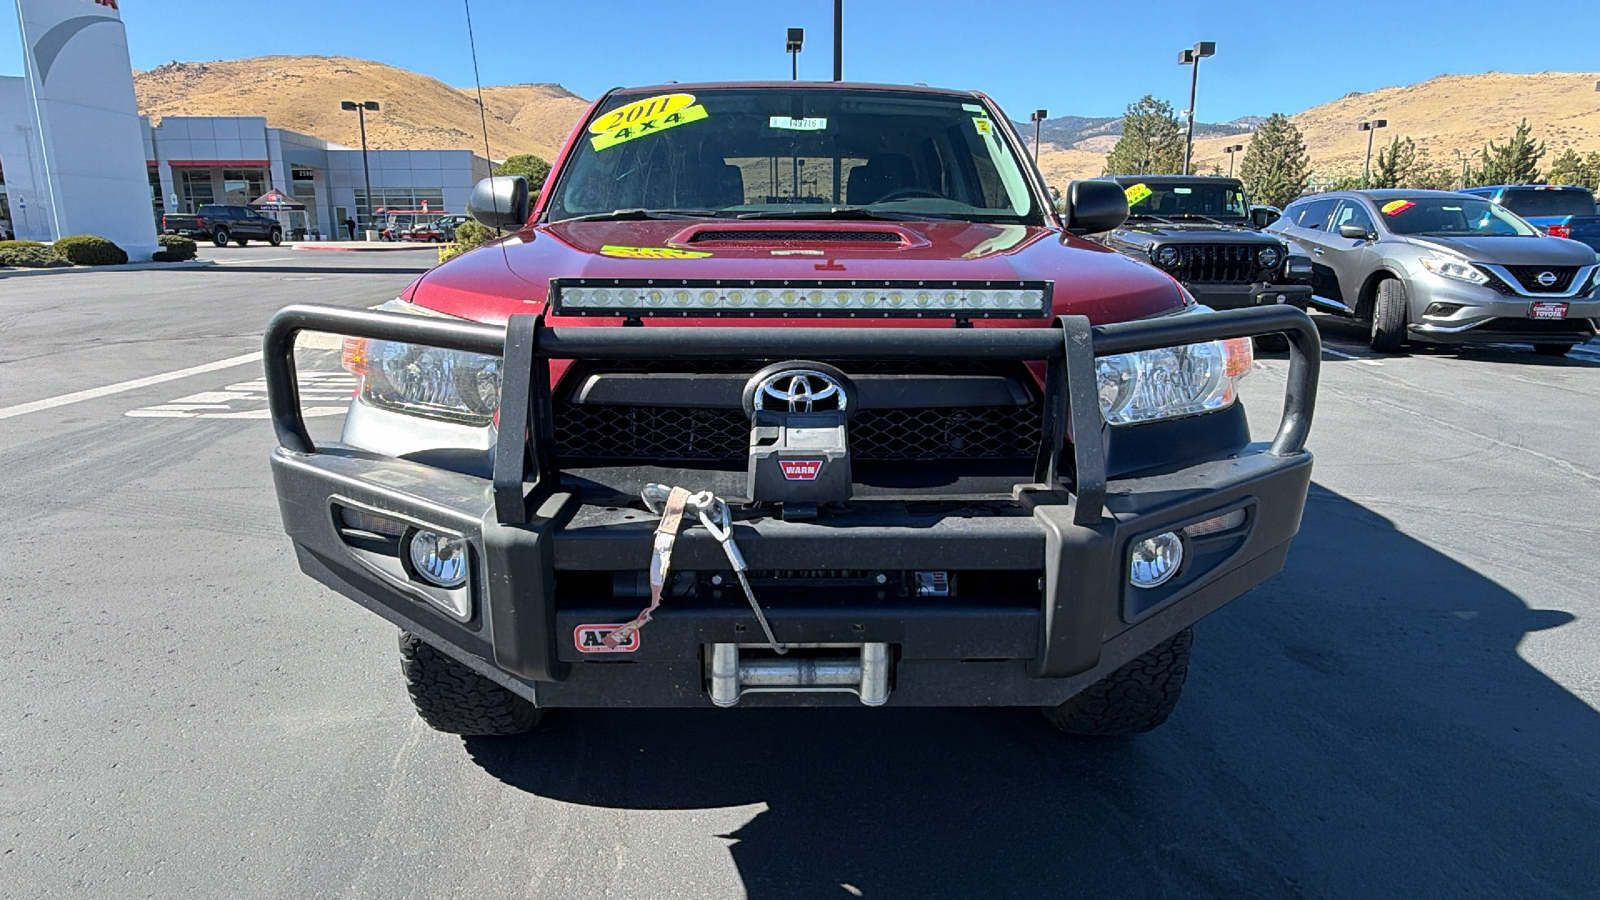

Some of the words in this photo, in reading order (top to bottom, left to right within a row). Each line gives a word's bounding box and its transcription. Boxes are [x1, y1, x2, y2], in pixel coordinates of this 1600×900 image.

[606, 97, 671, 130] 2011
[1127, 186, 1142, 198] 023
[786, 466, 815, 474] WARN
